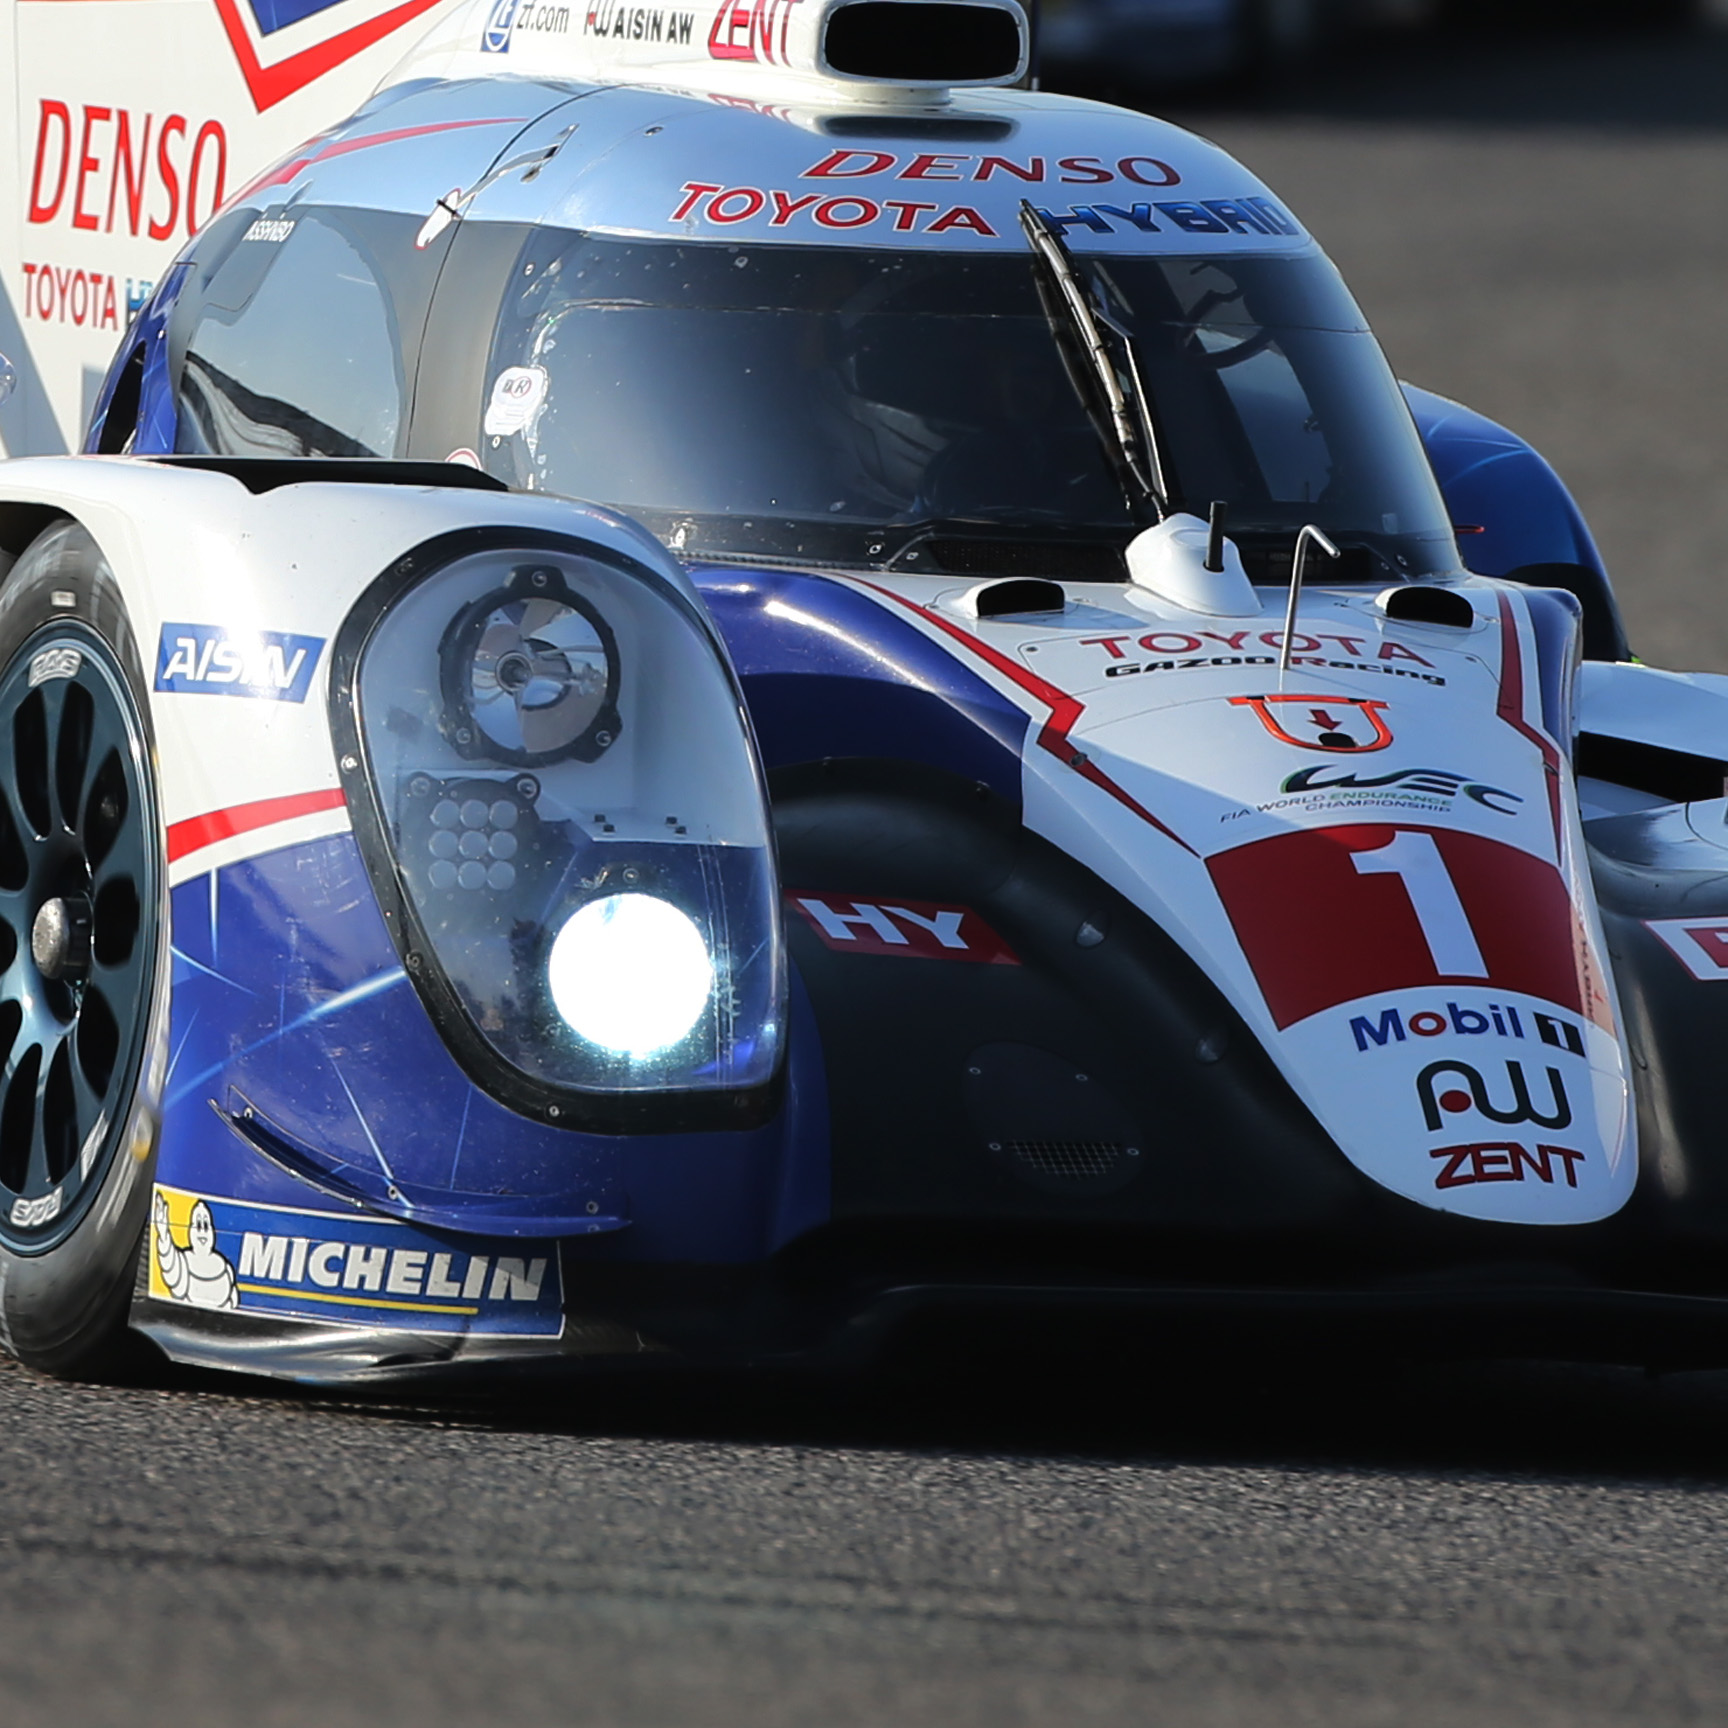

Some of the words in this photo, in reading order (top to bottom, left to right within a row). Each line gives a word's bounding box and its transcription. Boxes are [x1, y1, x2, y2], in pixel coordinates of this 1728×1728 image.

[613, 8, 664, 41] AISIN
[666, 12, 695, 45] AW
[28, 98, 227, 241] DENSO
[797, 148, 1183, 188] DENSO
[667, 181, 1001, 238] TOYOTA
[1040, 194, 1301, 237] HYBRID
[22, 262, 119, 332] TOYOTA
[1078, 629, 1436, 670] TOYOTA
[1104, 655, 1276, 679] GAZOO
[1290, 655, 1447, 687] Racing
[1220, 808, 1252, 824] FIA
[1256, 793, 1327, 813] WORLD
[1329, 790, 1453, 807] ENDURANCE
[1280, 764, 1525, 816] WEC
[1305, 798, 1452, 814] CHAMPIONSHIP
[796, 898, 970, 950] HY
[1348, 829, 1490, 979] 1
[1349, 1002, 1525, 1053] Mobil
[1429, 1141, 1586, 1190] ZENT
[238, 1231, 548, 1301] MICHELIN
